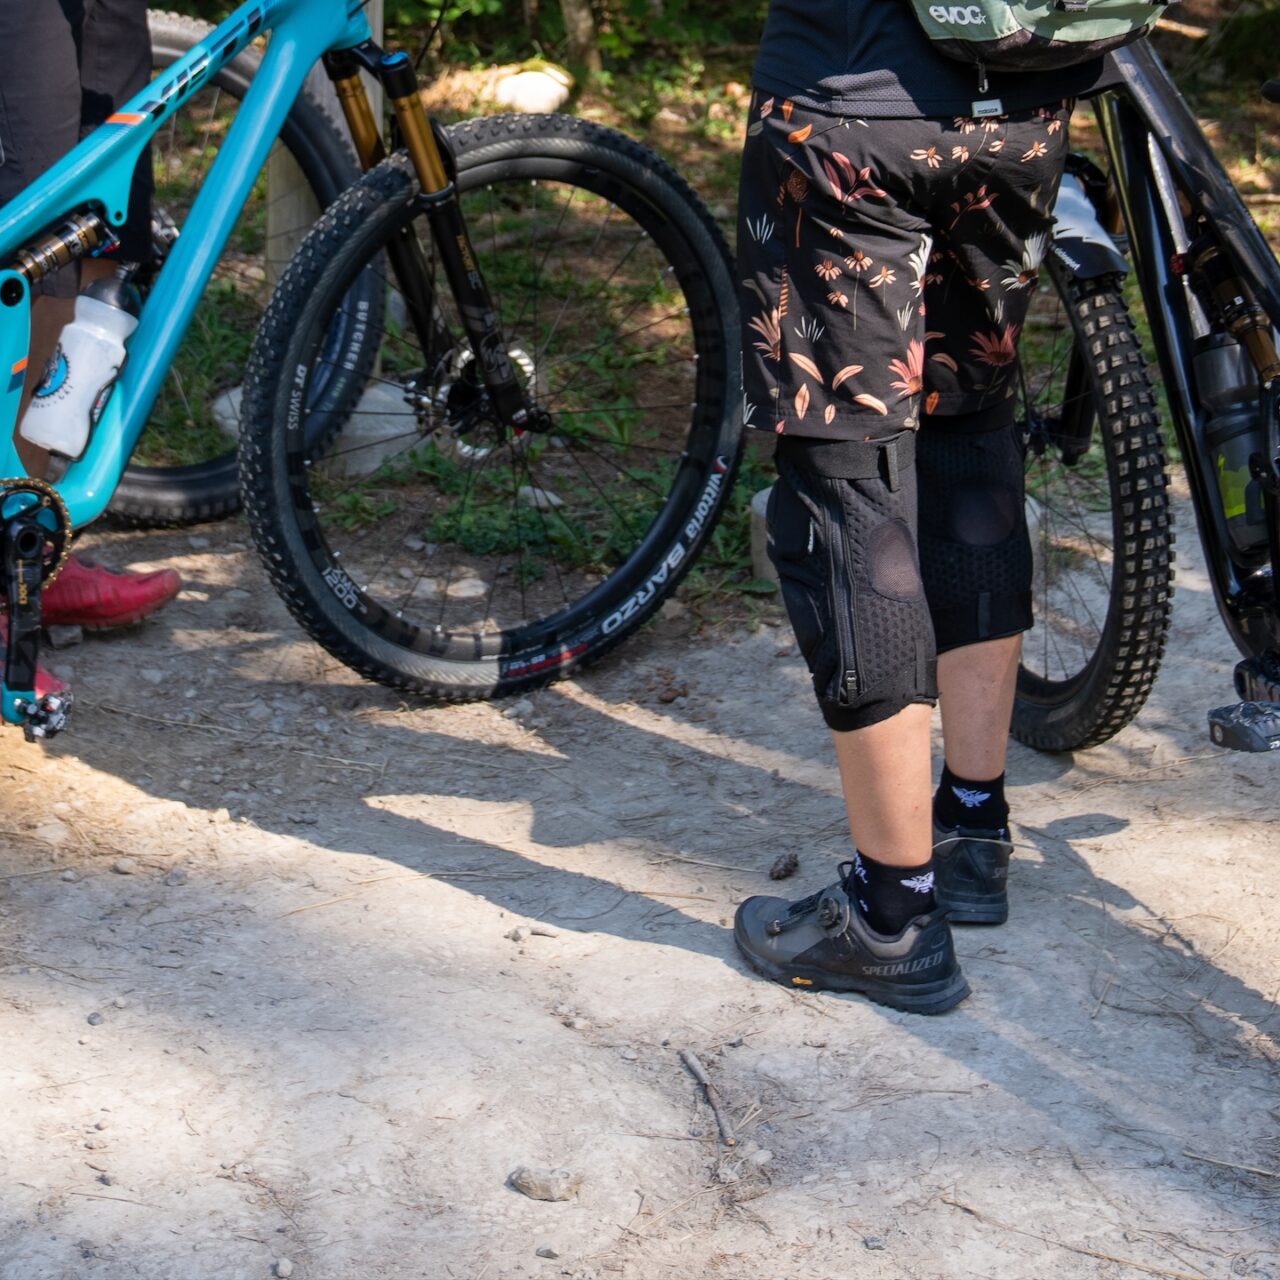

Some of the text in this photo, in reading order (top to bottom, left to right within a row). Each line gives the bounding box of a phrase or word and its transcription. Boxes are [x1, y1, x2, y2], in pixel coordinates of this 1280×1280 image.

[929, 5, 981, 25] evoc
[343, 300, 369, 371] BUTCHER
[287, 363, 308, 430] DT SWISS
[601, 473, 724, 634] vittoria BARZO
[862, 951, 944, 976] SPECIALIZED
